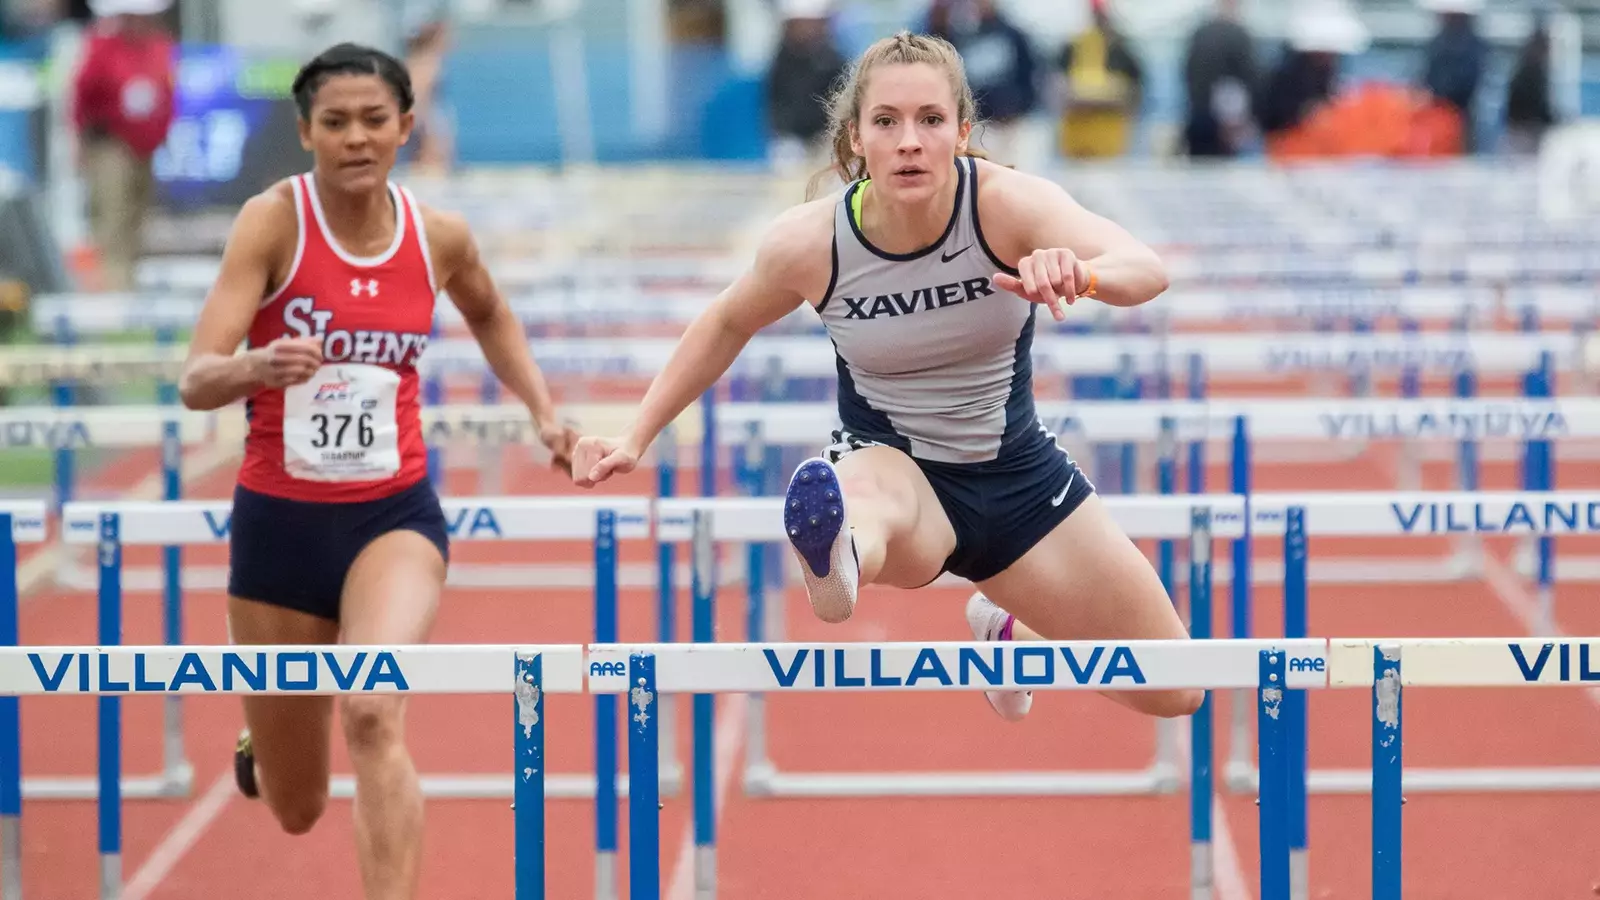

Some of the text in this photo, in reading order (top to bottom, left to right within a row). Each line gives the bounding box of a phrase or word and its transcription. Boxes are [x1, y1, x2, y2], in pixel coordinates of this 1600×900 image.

[842, 276, 996, 320] XAVIER
[310, 412, 375, 449] 376
[28, 651, 410, 692] VILLANOVA
[763, 645, 1147, 687] VILLANOVA
